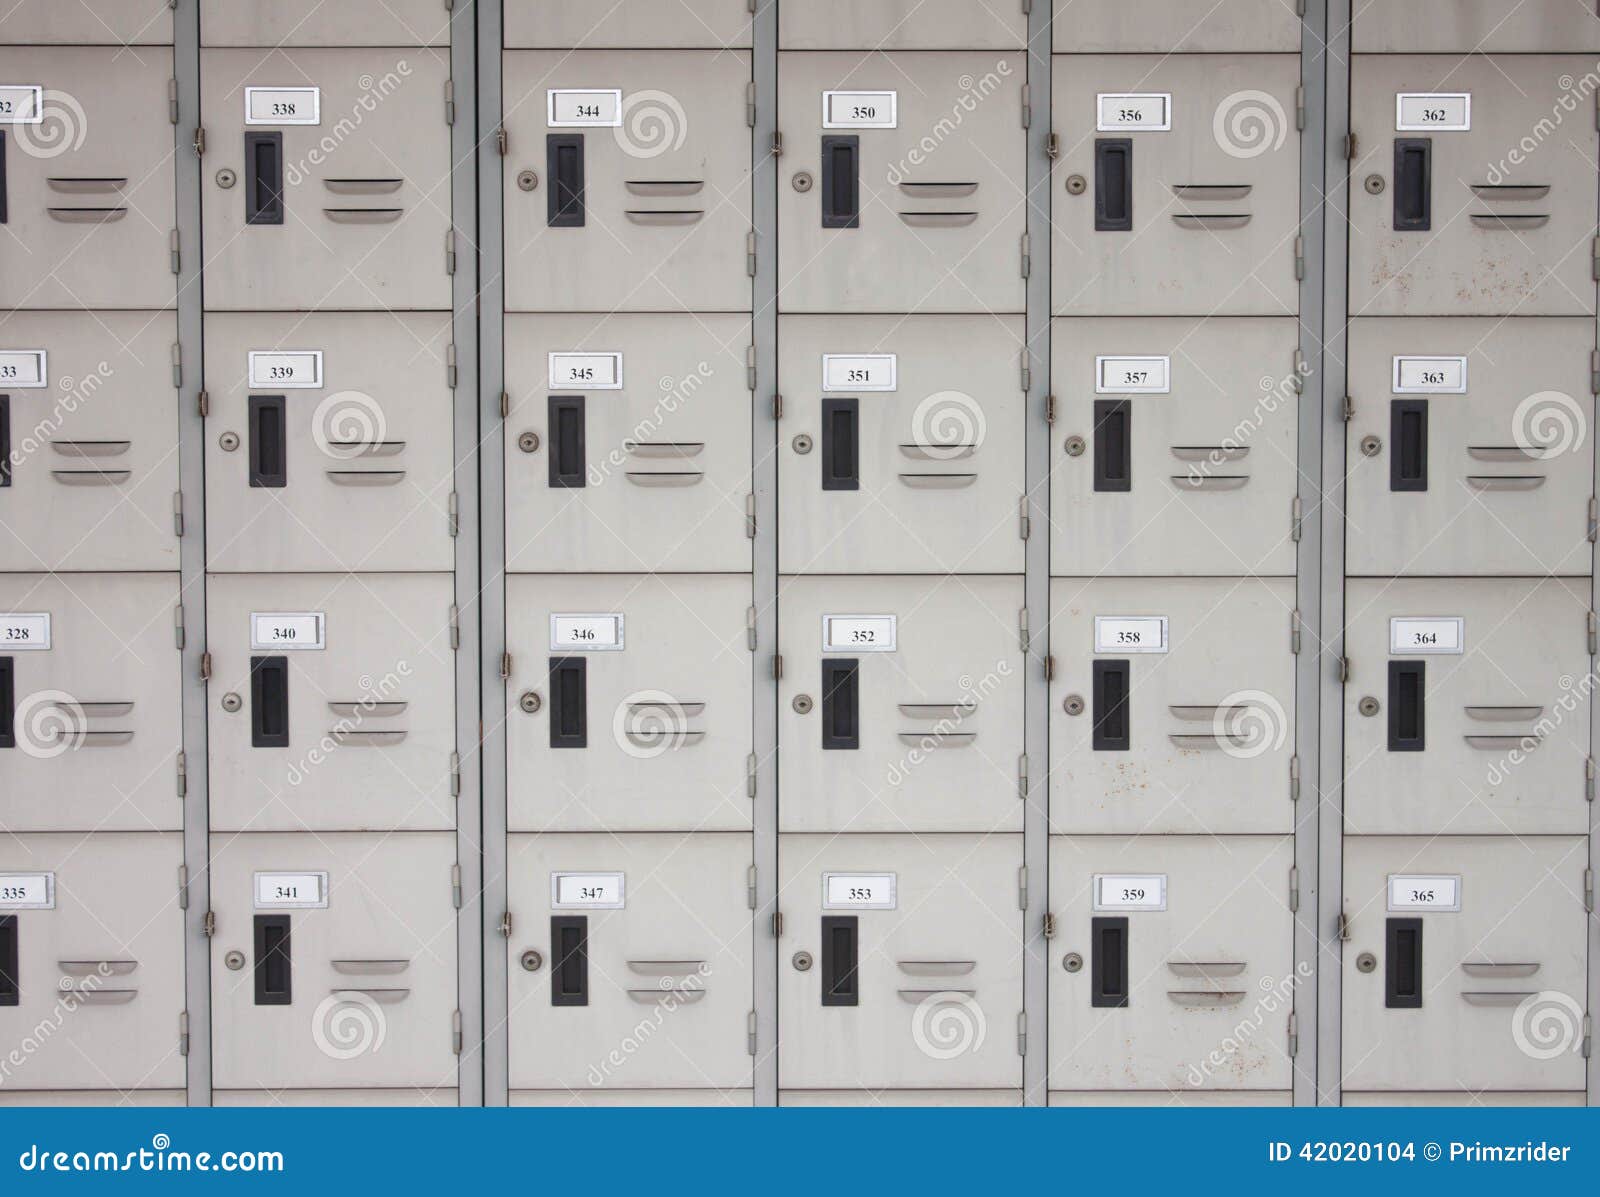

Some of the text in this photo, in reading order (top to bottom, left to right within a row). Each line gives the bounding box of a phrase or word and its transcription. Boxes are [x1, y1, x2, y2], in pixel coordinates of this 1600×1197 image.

[272, 103, 296, 115] 338
[576, 105, 600, 117] 344
[852, 106, 876, 119] 350
[1118, 109, 1142, 122] 356
[1422, 109, 1446, 122] 362
[0, 365, 17, 378] 33
[270, 367, 294, 378] 339
[569, 367, 593, 380] 345
[848, 370, 869, 382] 351
[1124, 371, 1148, 382] 357
[1422, 372, 1445, 384] 363
[6, 628, 30, 640] 328
[272, 627, 296, 640] 340
[572, 628, 595, 640] 346
[852, 630, 874, 642] 352
[1118, 631, 1141, 643] 358
[1414, 632, 1437, 645] 364
[2, 887, 26, 898] 335
[276, 886, 297, 898] 341
[581, 887, 604, 899] 347
[849, 888, 872, 899] 353
[1122, 888, 1145, 900] 359
[1411, 890, 1434, 902] 365
